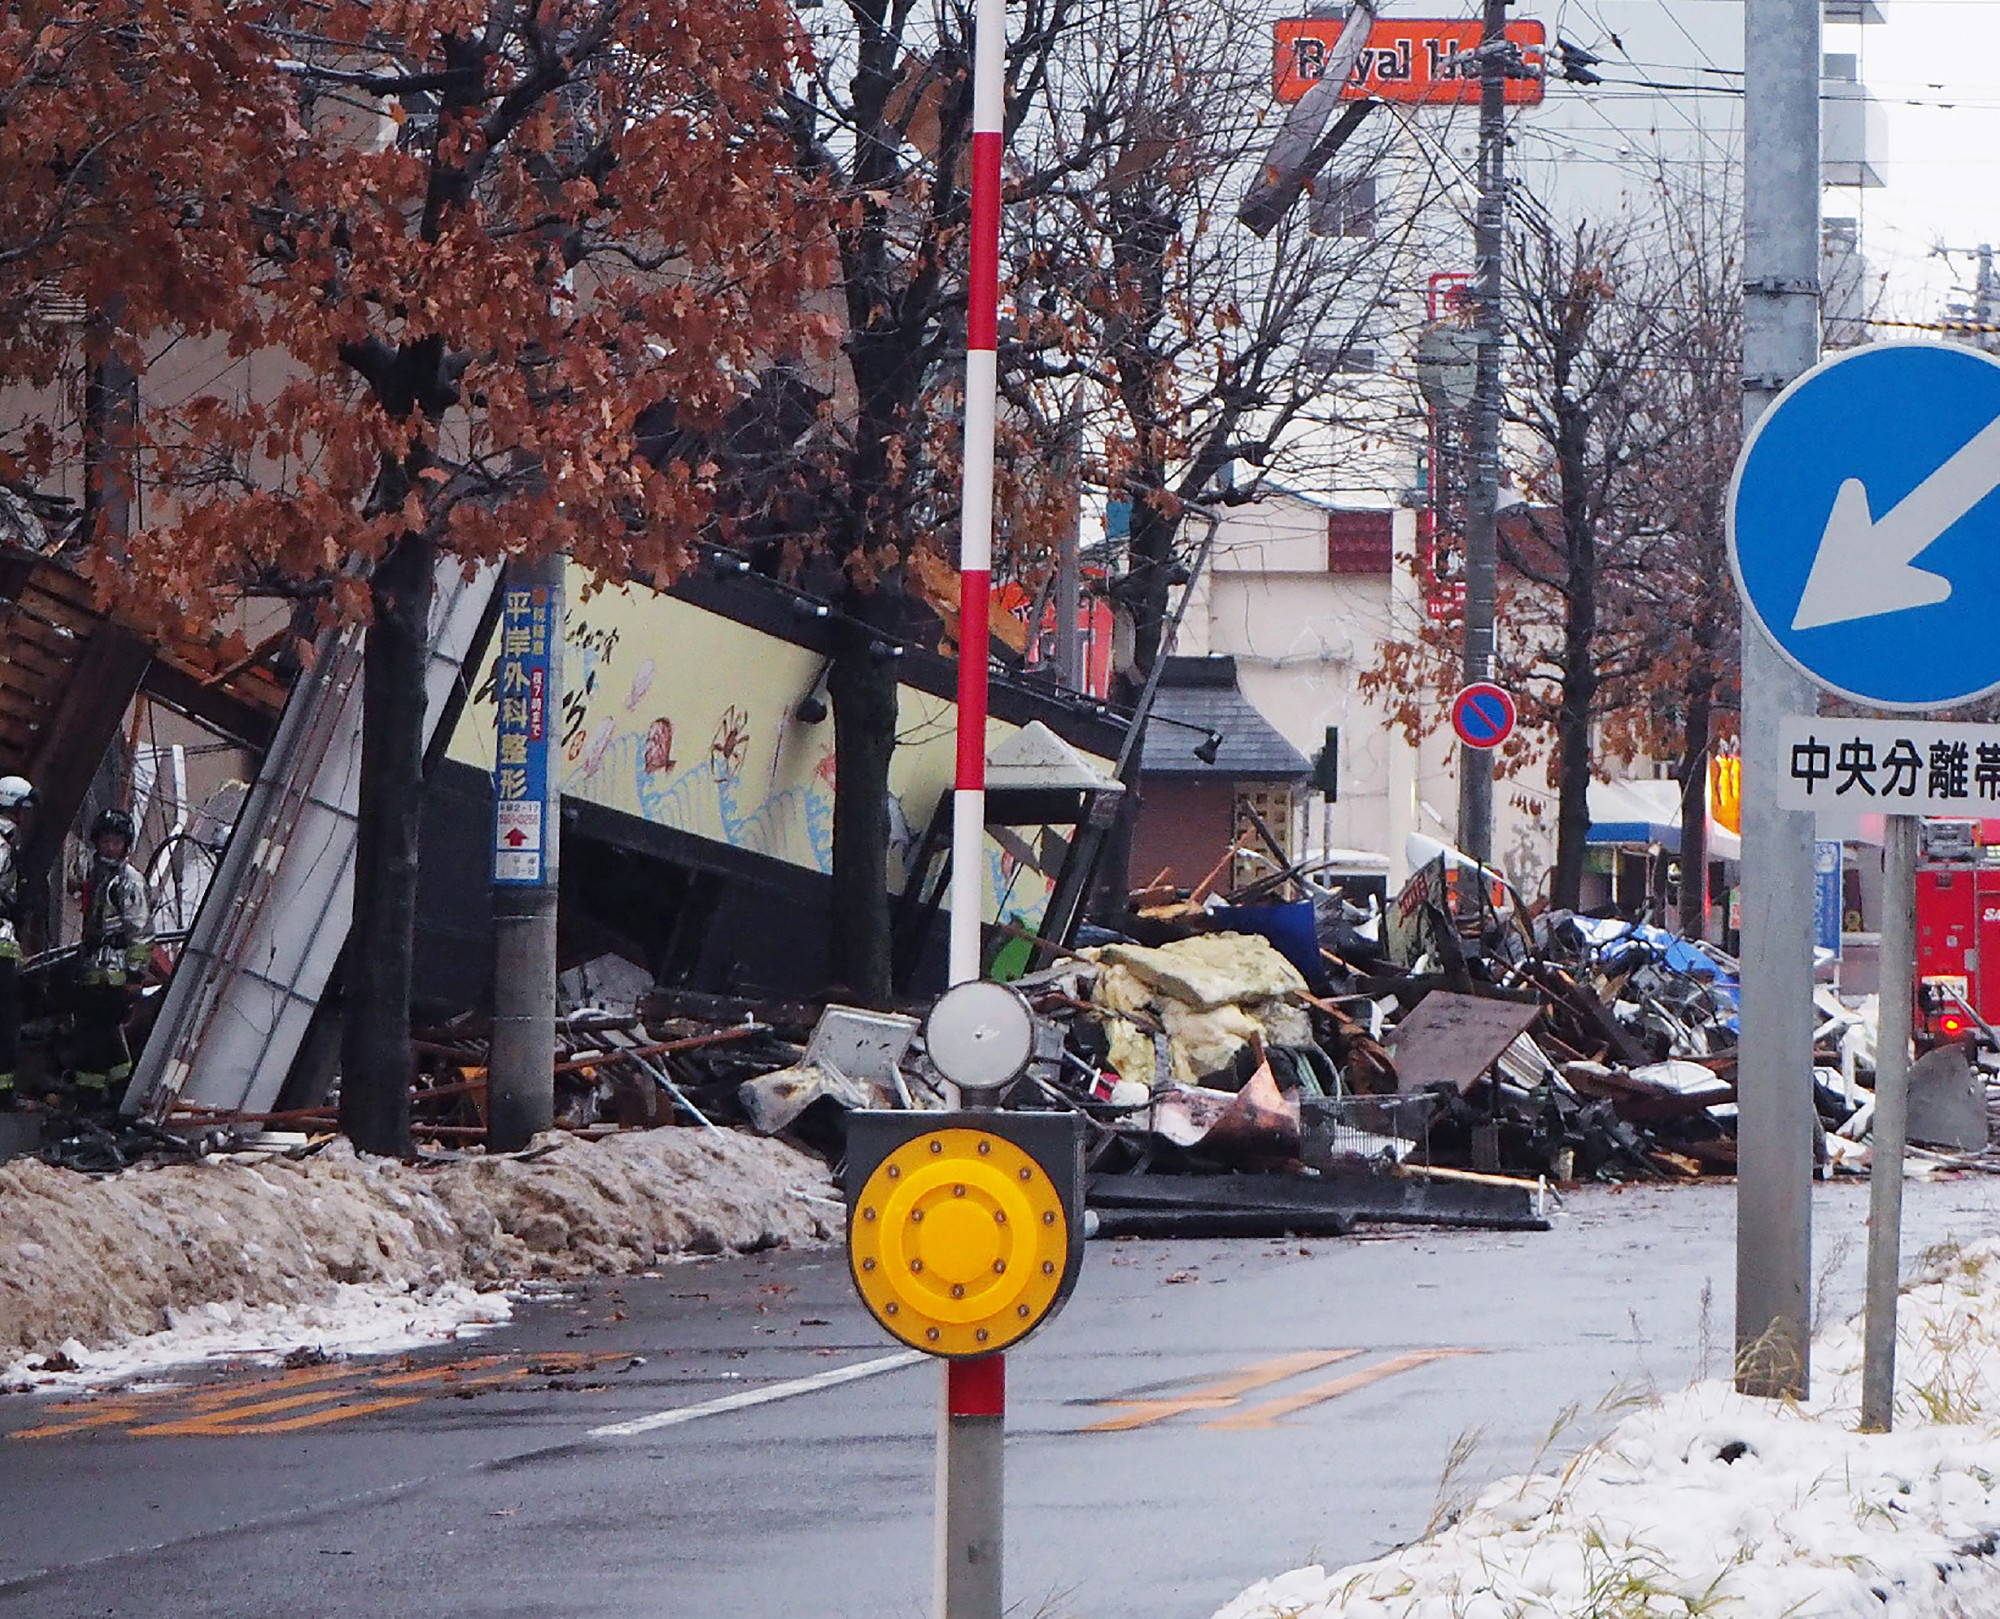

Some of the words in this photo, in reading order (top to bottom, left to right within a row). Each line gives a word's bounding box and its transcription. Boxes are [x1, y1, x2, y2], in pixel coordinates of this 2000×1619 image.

[1292, 38, 1411, 89] Ryal
[499, 591, 532, 799] 平岸外科整形
[1790, 735, 2000, 801] 中央分離帯
